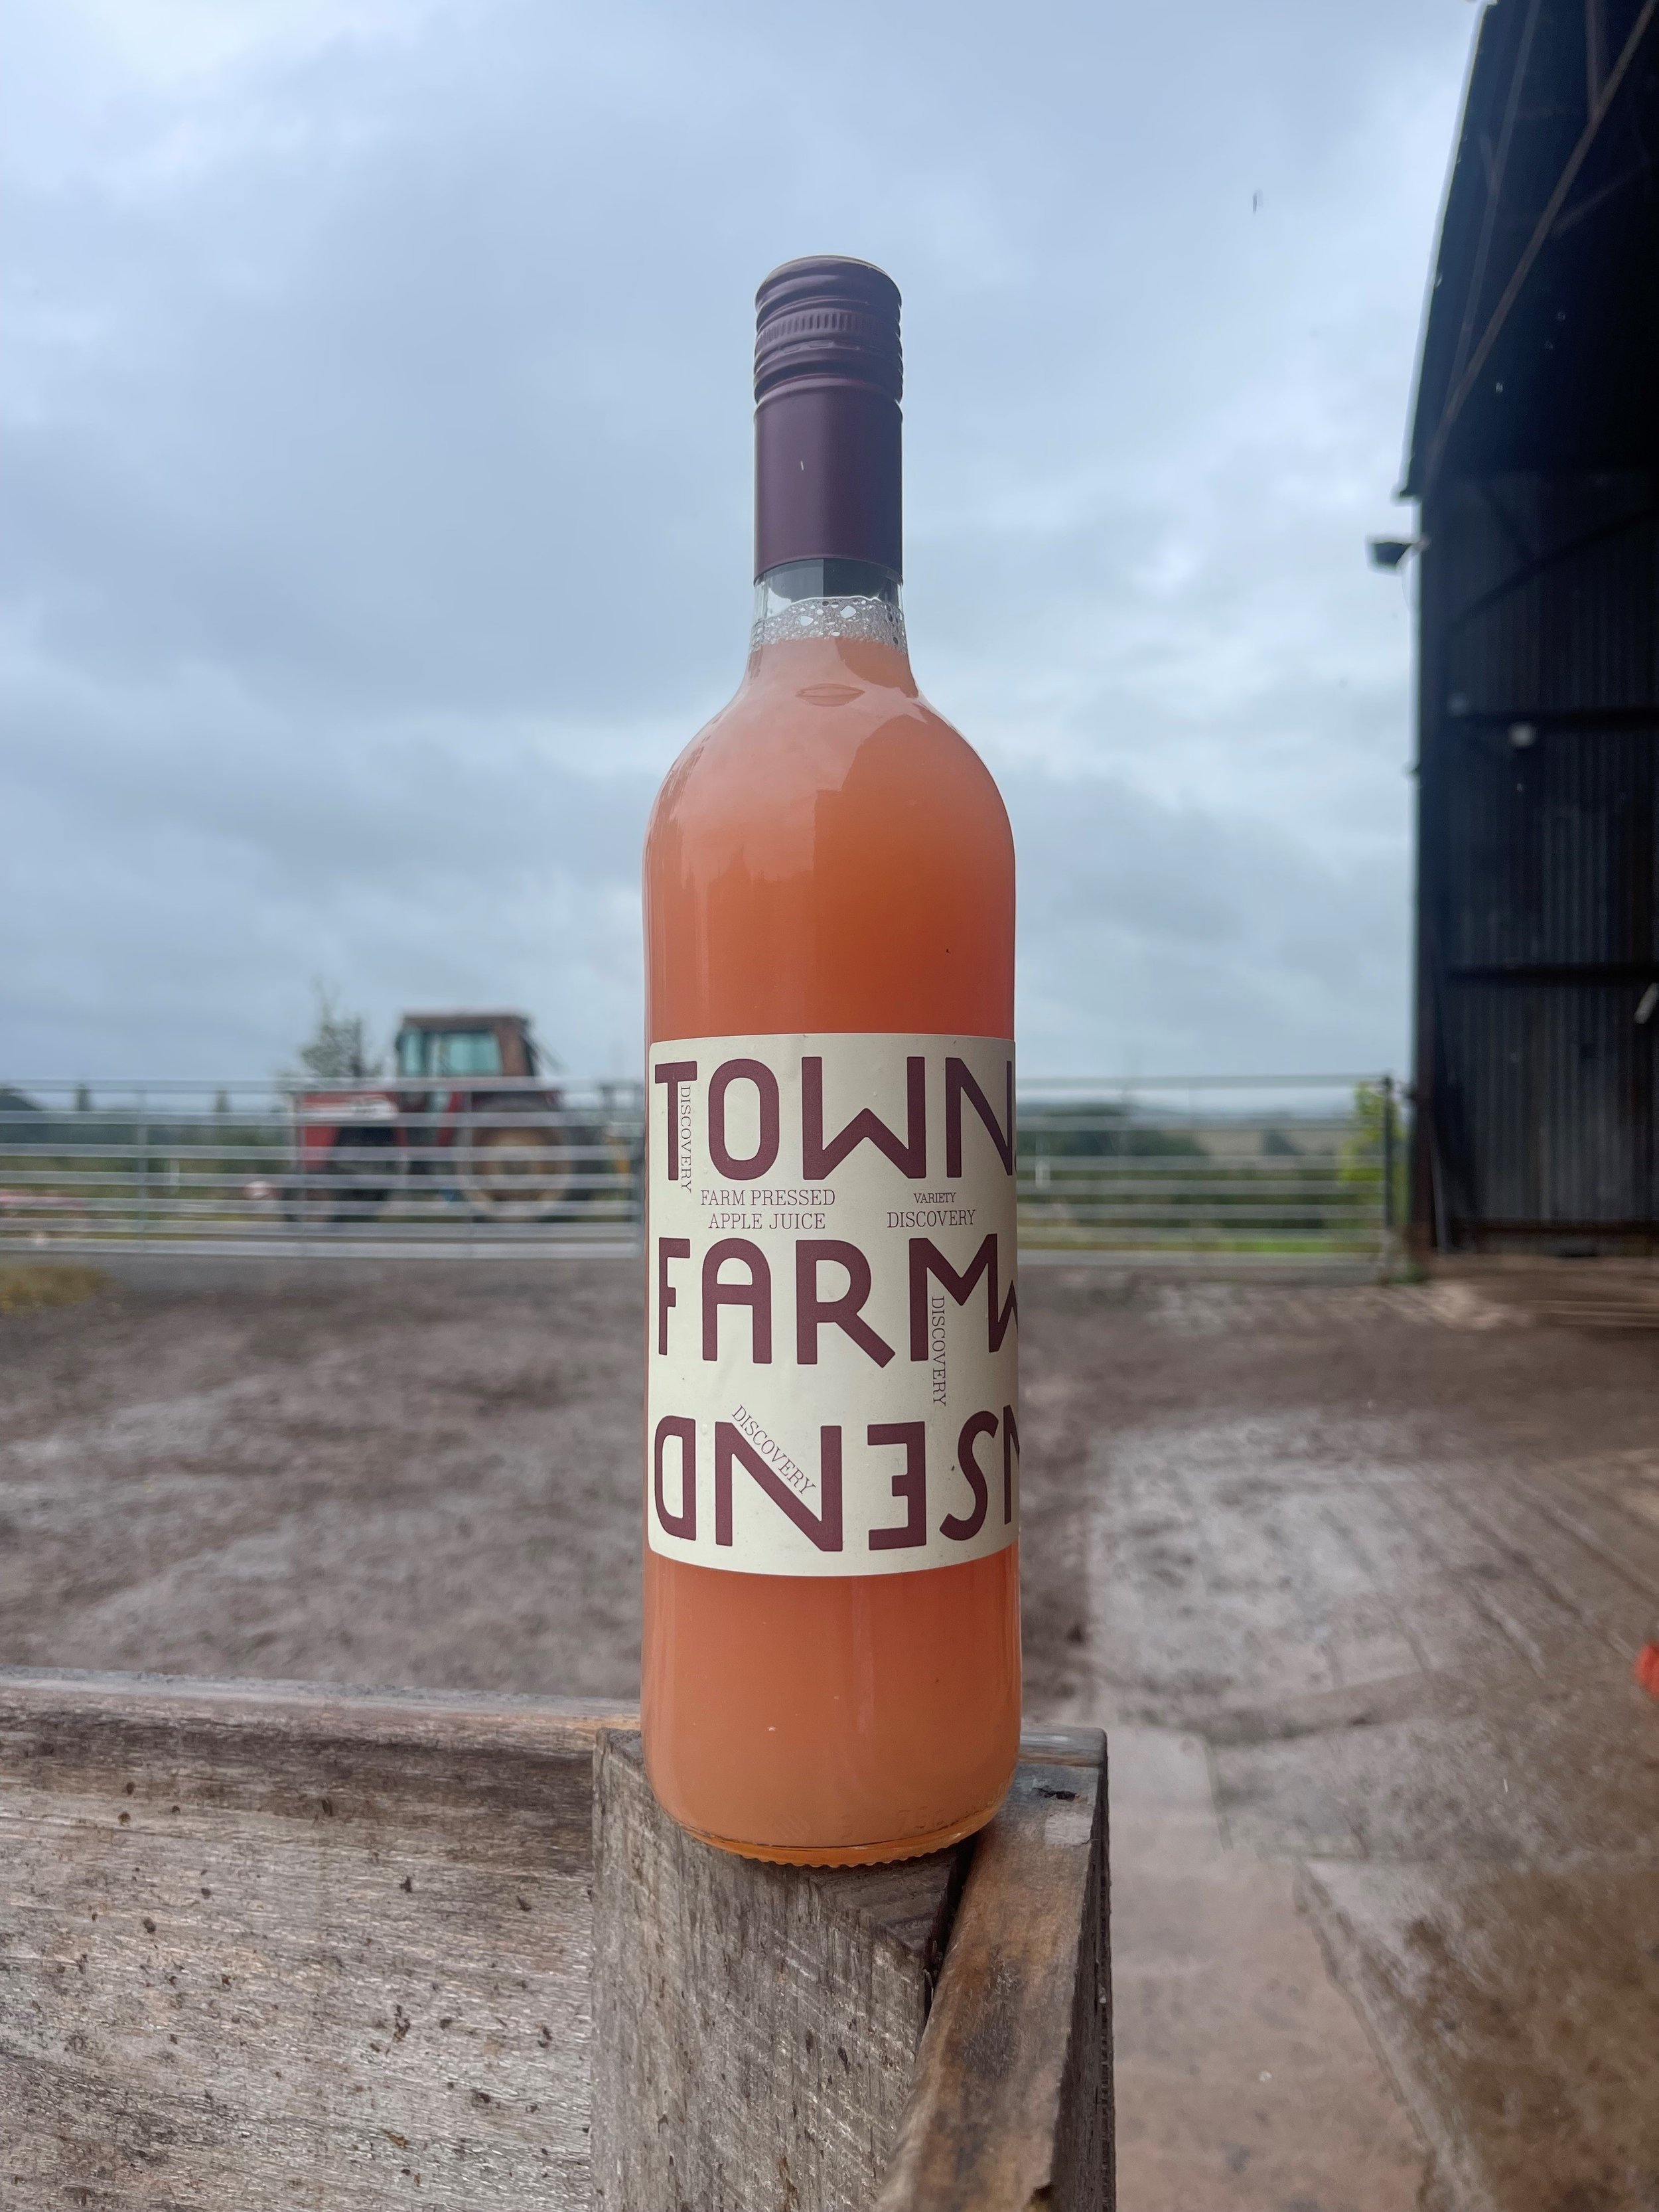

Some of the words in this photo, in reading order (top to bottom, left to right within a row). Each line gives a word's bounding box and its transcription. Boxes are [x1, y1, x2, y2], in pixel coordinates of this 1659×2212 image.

[680, 1085, 692, 1193] DISCOVERY
[700, 1189, 745, 1206] FARM
[750, 1189, 835, 1206] PRESSED
[912, 1192, 957, 1204] VARIETY
[707, 1212, 763, 1230] APPLE
[768, 1211, 826, 1230] JUICE
[887, 1209, 976, 1228] DISCOVERY
[930, 1295, 947, 1407] DISCOVERY
[731, 1404, 816, 1495] DISCOVERY
